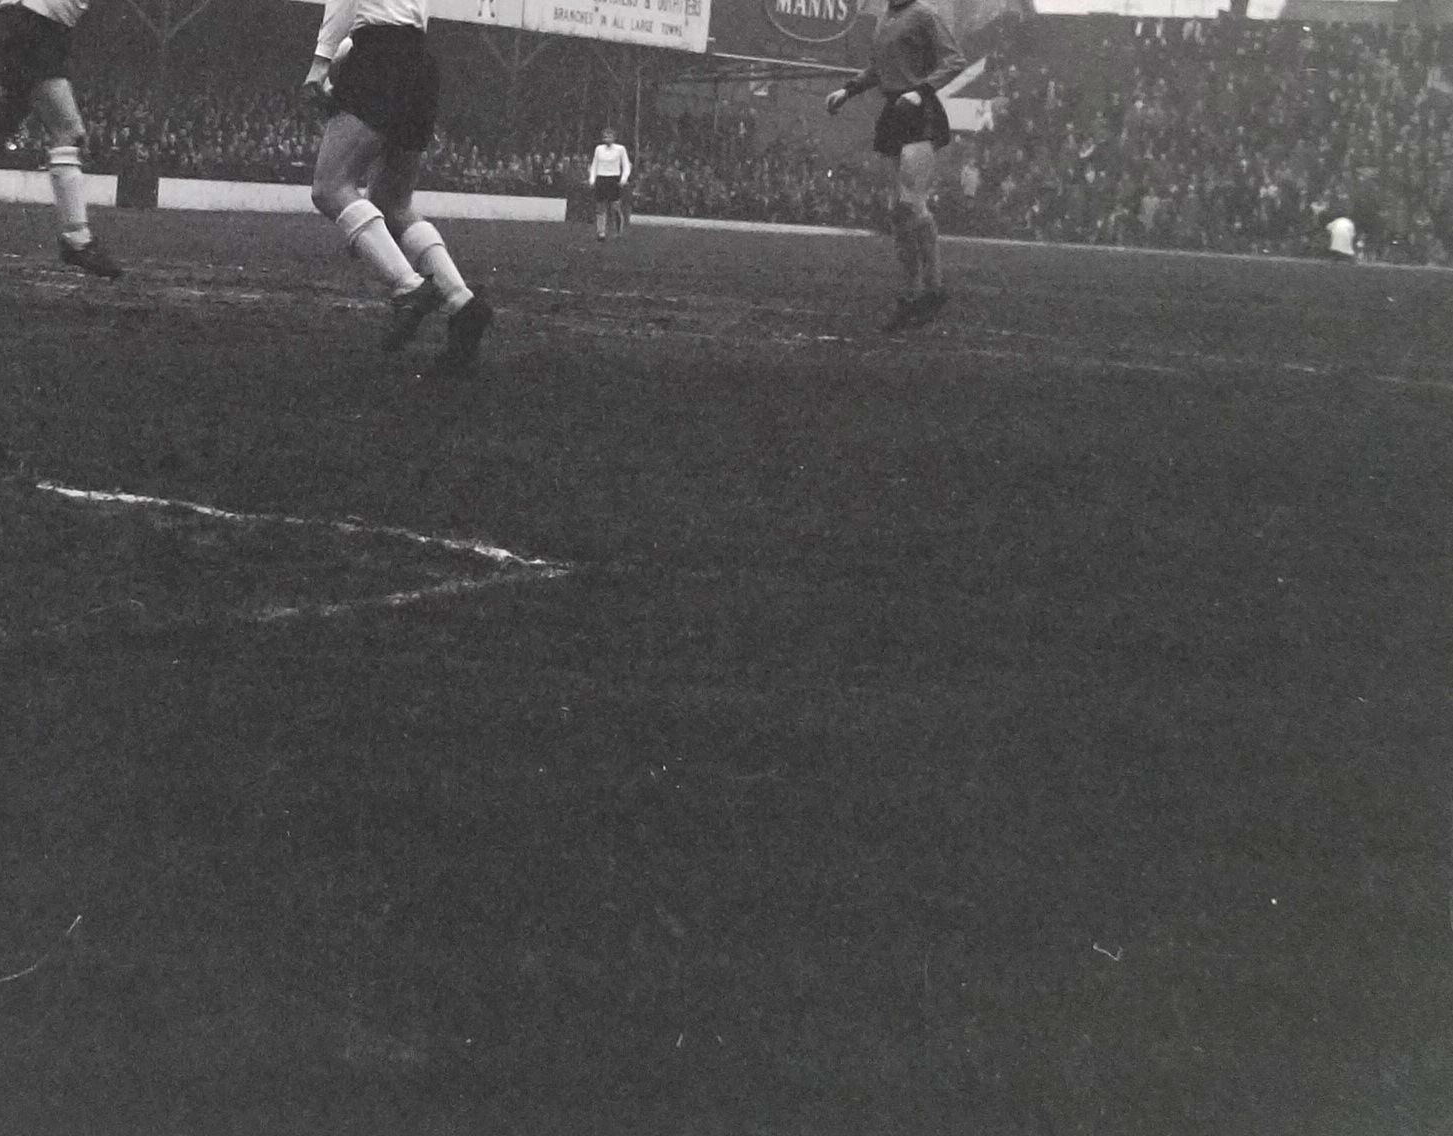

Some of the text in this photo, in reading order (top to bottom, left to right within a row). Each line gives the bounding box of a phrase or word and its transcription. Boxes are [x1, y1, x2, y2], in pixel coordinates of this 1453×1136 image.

[553, 6, 593, 25] BRANCHES
[613, 16, 625, 30] ALL
[630, 19, 654, 34] LARGE
